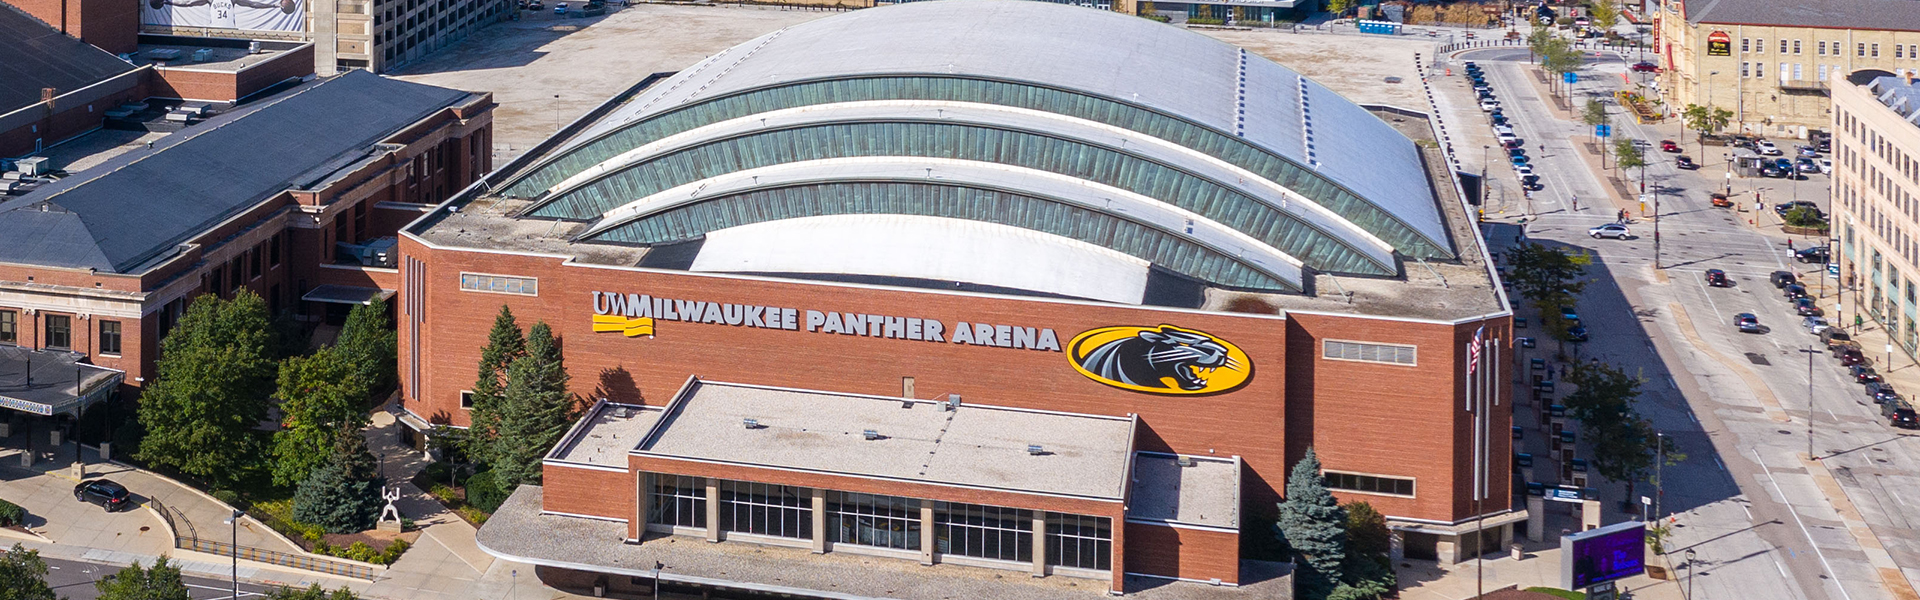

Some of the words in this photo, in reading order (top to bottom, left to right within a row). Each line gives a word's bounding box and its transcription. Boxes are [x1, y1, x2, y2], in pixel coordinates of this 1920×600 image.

[217, 10, 227, 19] 34
[806, 310, 945, 342] PANTHER
[951, 321, 1061, 351] ARENA
